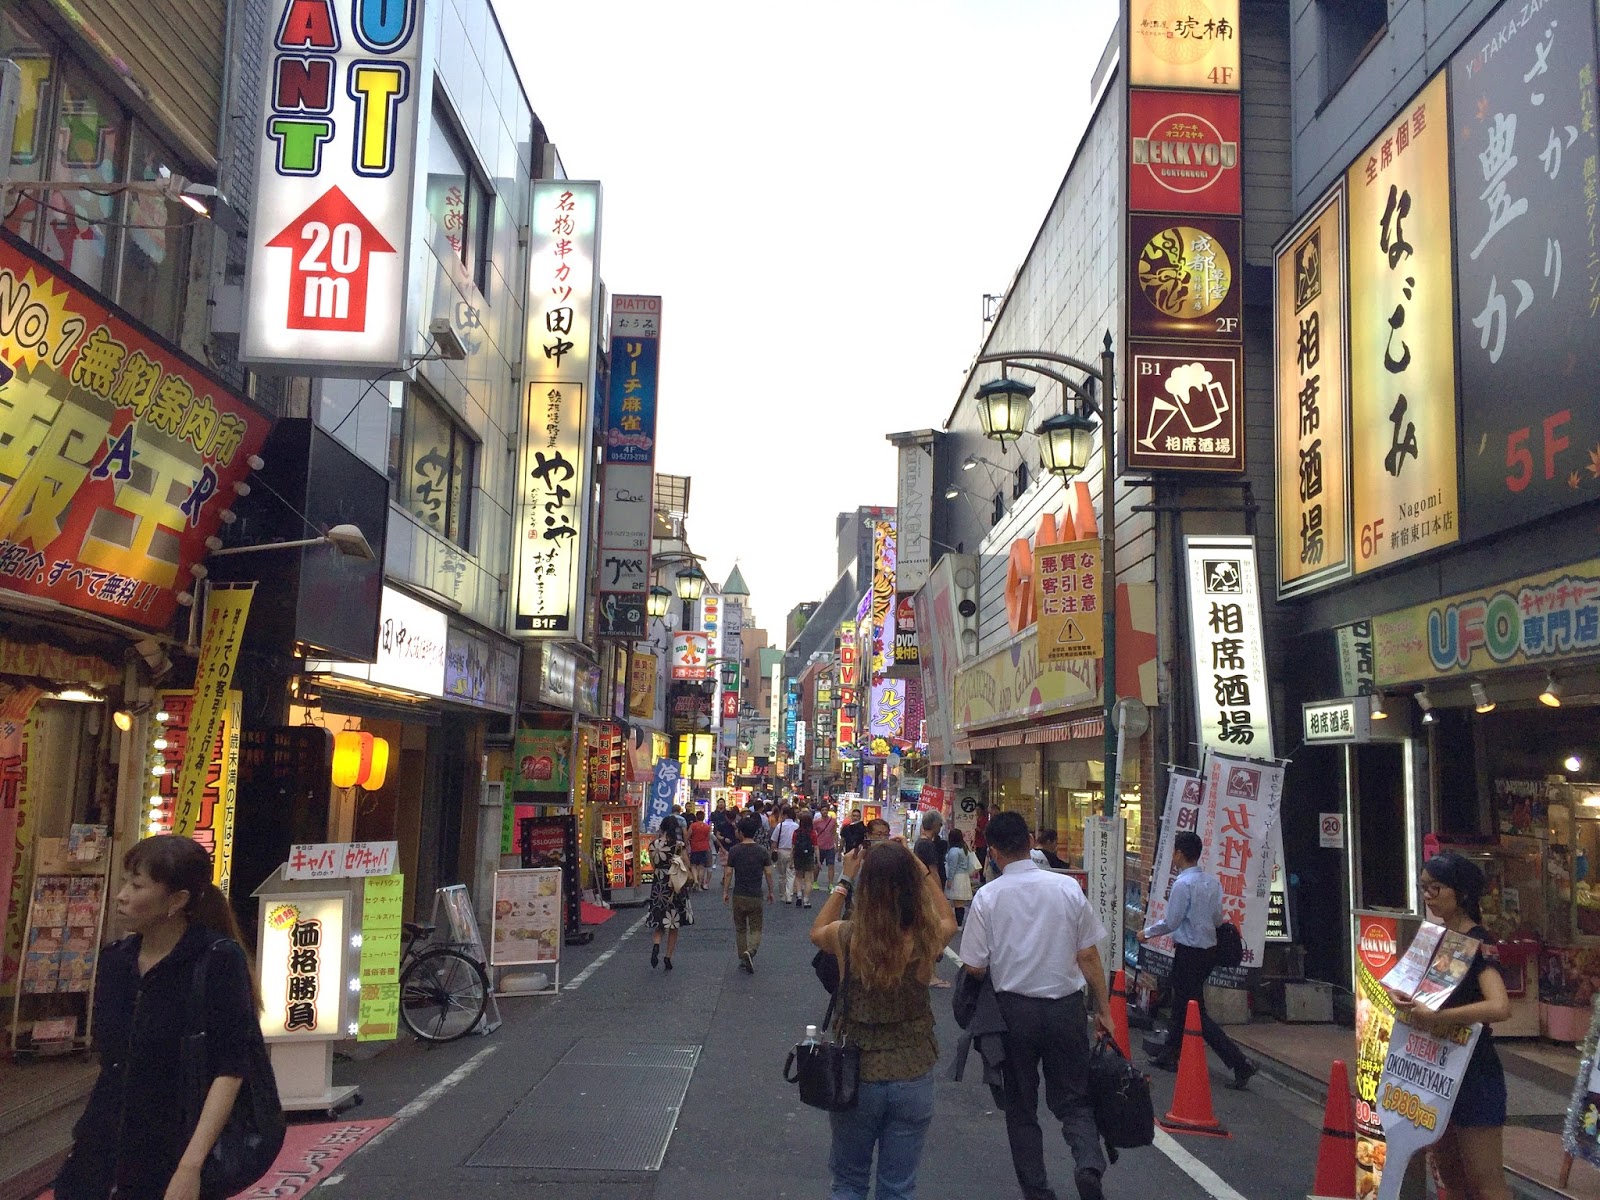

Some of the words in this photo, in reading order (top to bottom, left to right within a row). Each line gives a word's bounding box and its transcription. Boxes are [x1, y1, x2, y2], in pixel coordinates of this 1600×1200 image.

[1207, 66, 1234, 84] 4F
[1171, 123, 1199, 131] ステーキ
[1365, 103, 1427, 187] 全席個室
[299, 222, 362, 274] 20
[303, 275, 350, 319] m
[615, 298, 657, 311] PIATTO
[543, 306, 574, 369] 田中
[1215, 317, 1238, 333] 2F
[1140, 362, 1162, 376] B1
[620, 342, 642, 431] リーチ麻雀
[1165, 436, 1231, 454] 相席酒場
[1297, 310, 1324, 565] 相席酒場
[1505, 409, 1572, 492] 5F
[1399, 488, 1443, 521] Nagomi
[1360, 518, 1385, 559] 6F
[1390, 511, 1453, 549] 新宿東口本店
[1041, 552, 1095, 574] 悪質な
[1042, 573, 1095, 595] 客引き
[1043, 594, 1097, 615] に注意
[532, 618, 557, 629] B1F
[1428, 591, 1521, 672] UFO
[1523, 604, 1600, 649] 専門店
[1208, 601, 1255, 745] 相席酒場
[1310, 709, 1350, 735] 相席酒場
[1324, 820, 1339, 832] 20
[290, 849, 336, 871] キャバ
[344, 848, 389, 869] セクキャバ
[286, 921, 320, 1029] 価格勝負
[360, 1002, 398, 1019] セール
[1405, 1032, 1440, 1066] STEAK
[1439, 1045, 1449, 1068] &
[1386, 1053, 1455, 1099] OKONOMIYAKI
